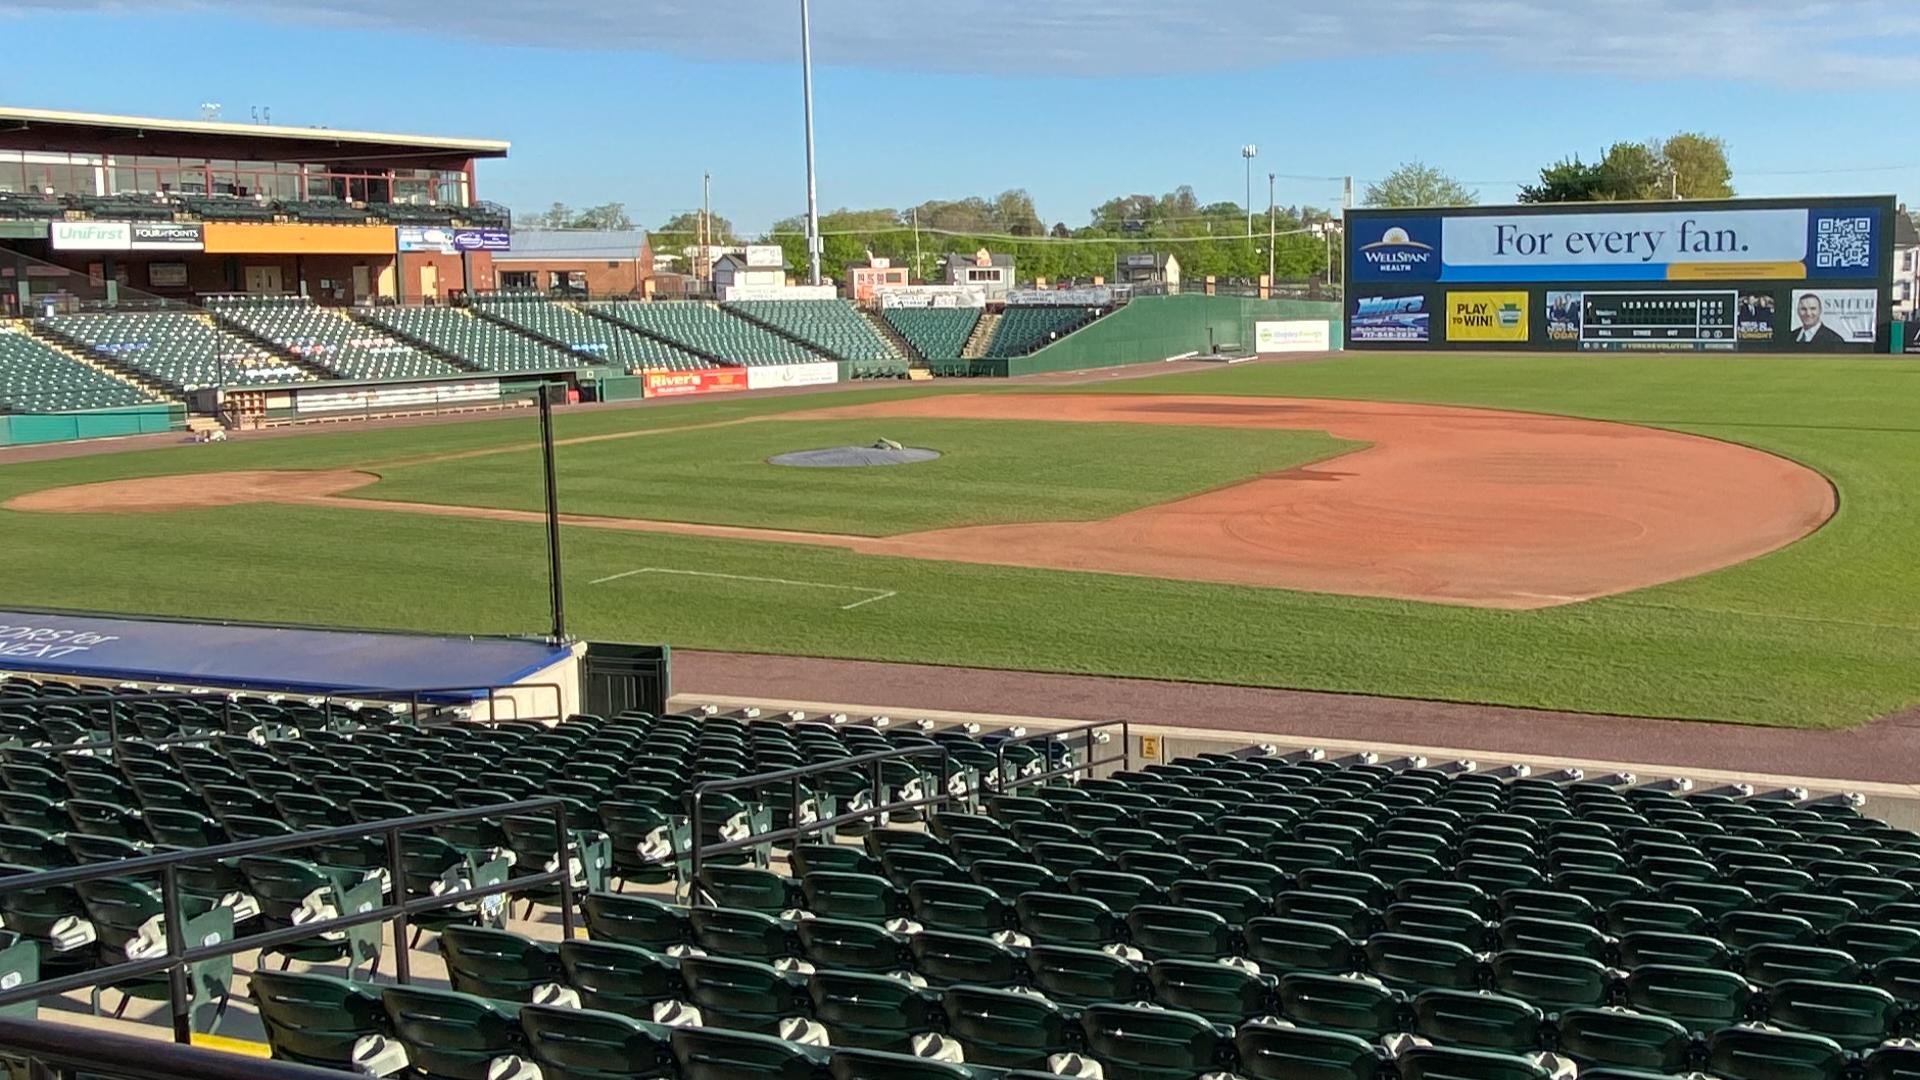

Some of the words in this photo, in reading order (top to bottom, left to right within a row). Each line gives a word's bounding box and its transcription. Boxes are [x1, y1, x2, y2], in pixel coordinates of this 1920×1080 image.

[59, 226, 123, 240] UniFirst
[135, 229, 162, 238] FOUR
[168, 229, 199, 238] POINTS
[1493, 224, 1553, 256] For
[1565, 230, 1664, 262] every
[1677, 220, 1749, 254] fan.
[1457, 303, 1488, 315] PLAY
[1824, 298, 1874, 309] SMITH
[1453, 316, 1462, 325] TO
[1464, 315, 1493, 327] WIN!
[1548, 331, 1578, 340] TODAY
[650, 372, 701, 388] River's
